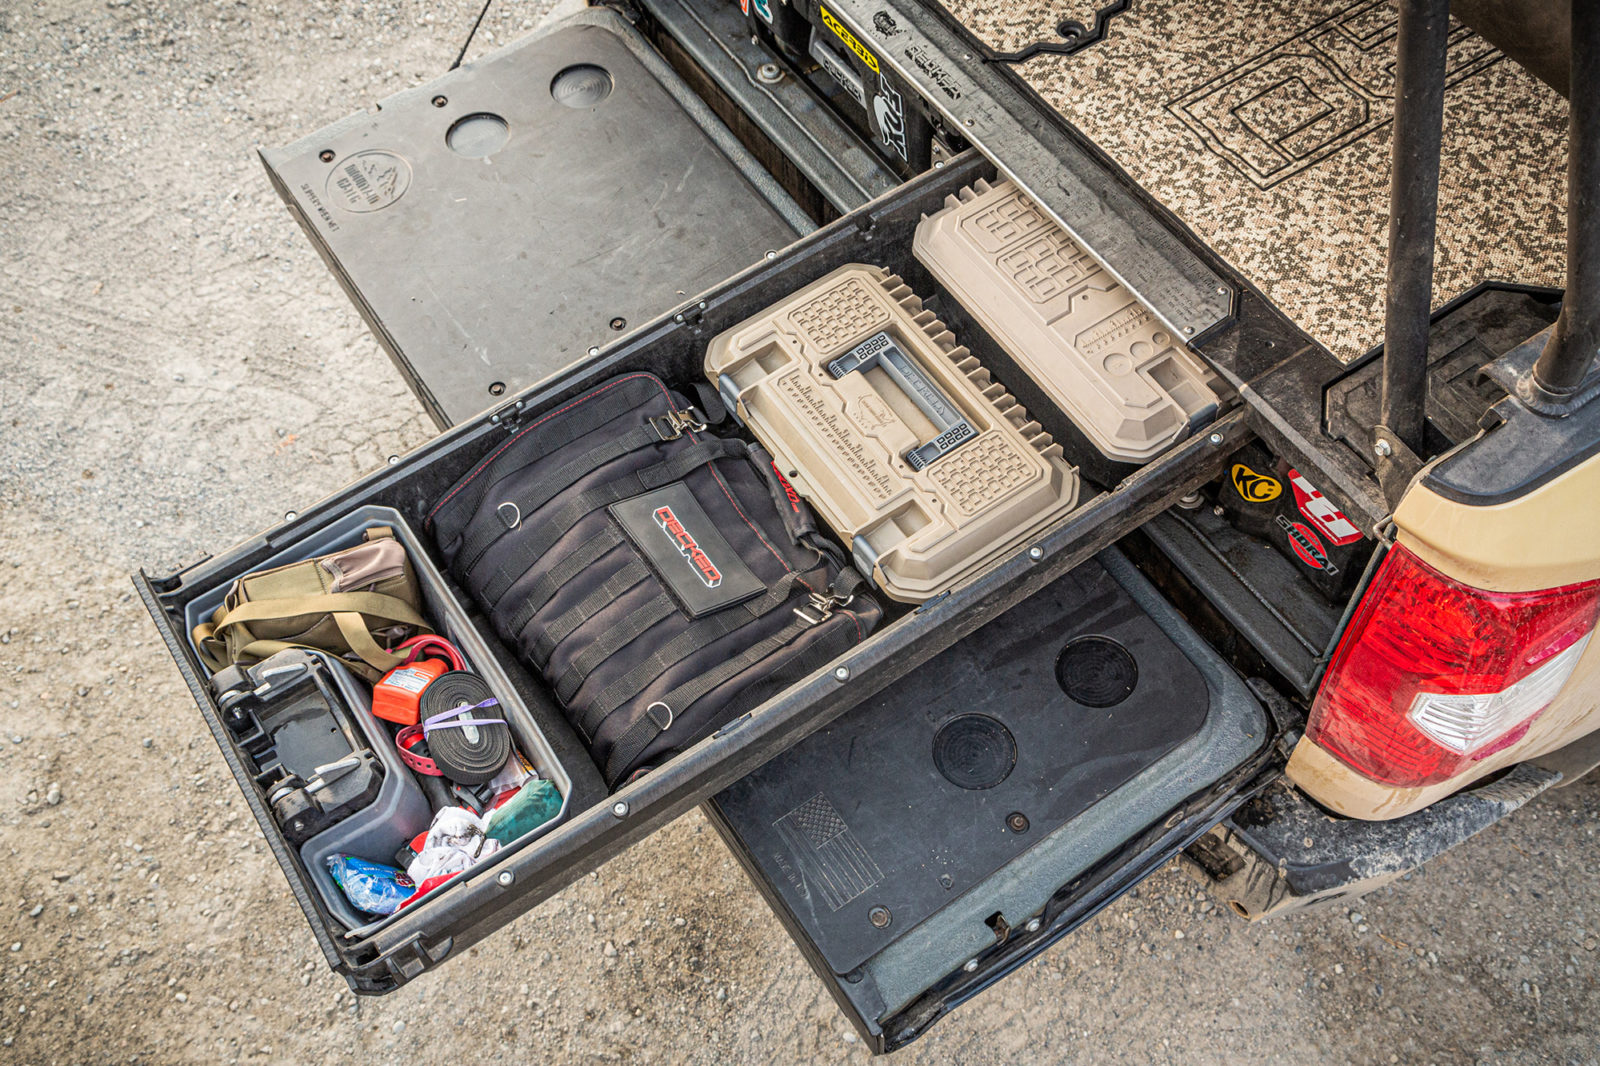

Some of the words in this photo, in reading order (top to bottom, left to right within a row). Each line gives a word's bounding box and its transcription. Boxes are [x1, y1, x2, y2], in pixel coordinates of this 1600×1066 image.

[904, 46, 961, 100] DECKED
[1235, 468, 1275, 499] KC
[654, 505, 722, 587] DECKED
[1277, 514, 1339, 576] SHORAI
